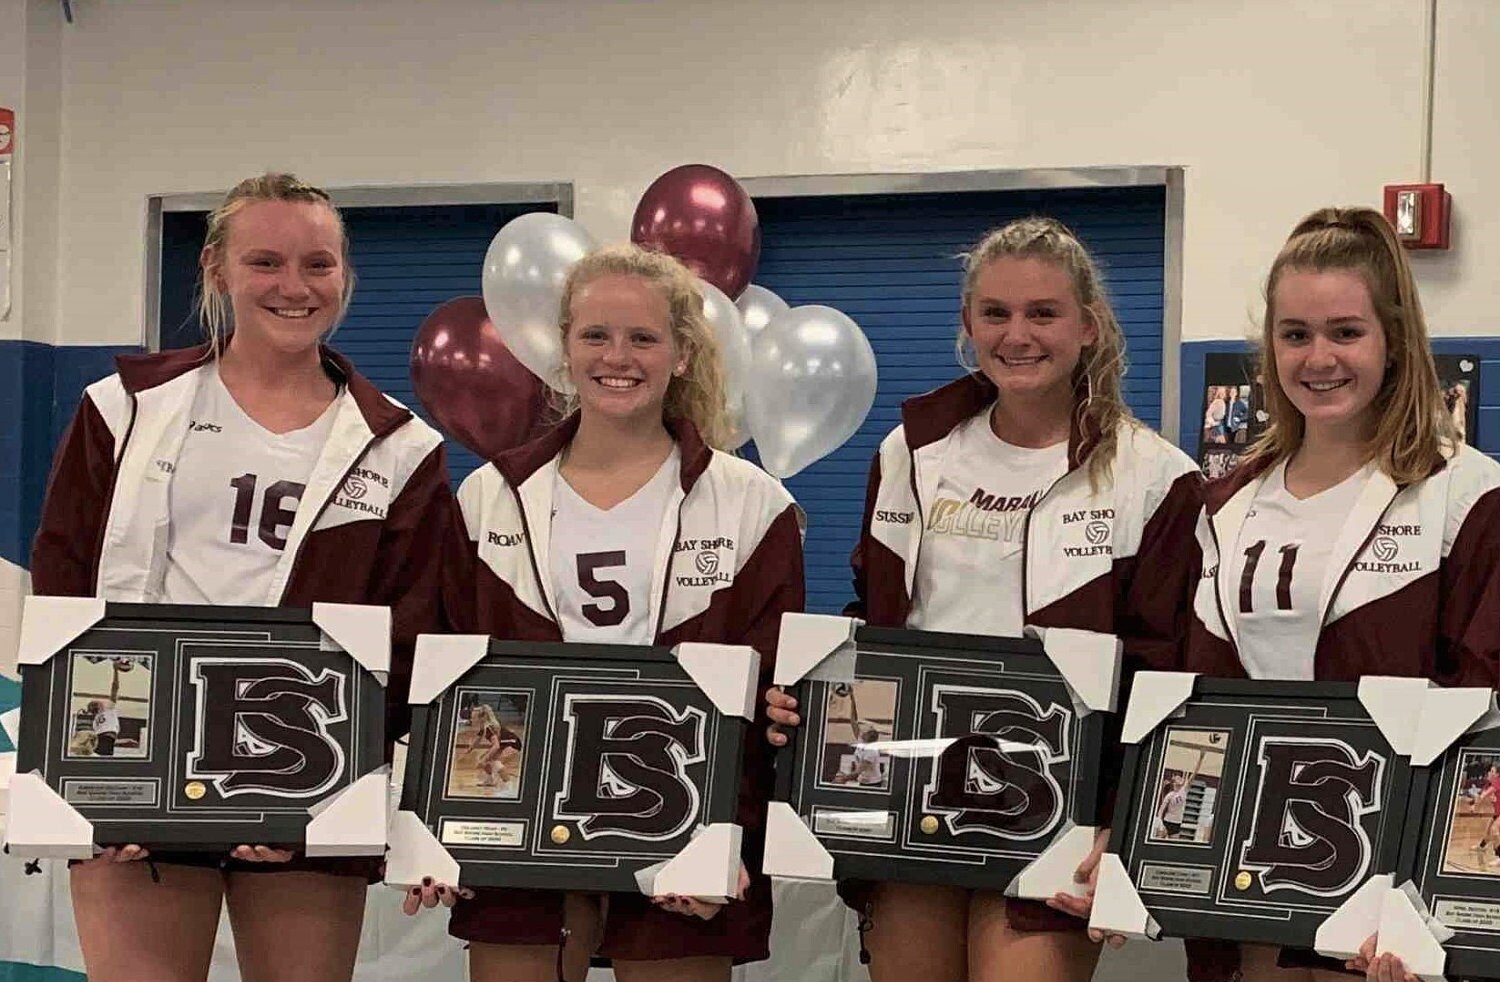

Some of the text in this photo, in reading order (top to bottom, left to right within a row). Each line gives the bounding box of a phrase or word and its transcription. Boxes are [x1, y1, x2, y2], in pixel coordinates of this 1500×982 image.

[353, 467, 389, 489] HORE
[1063, 509, 1115, 524] BAY SHO
[1379, 525, 1422, 537] SHORE
[1239, 539, 1301, 613] 11
[576, 550, 630, 627] 5
